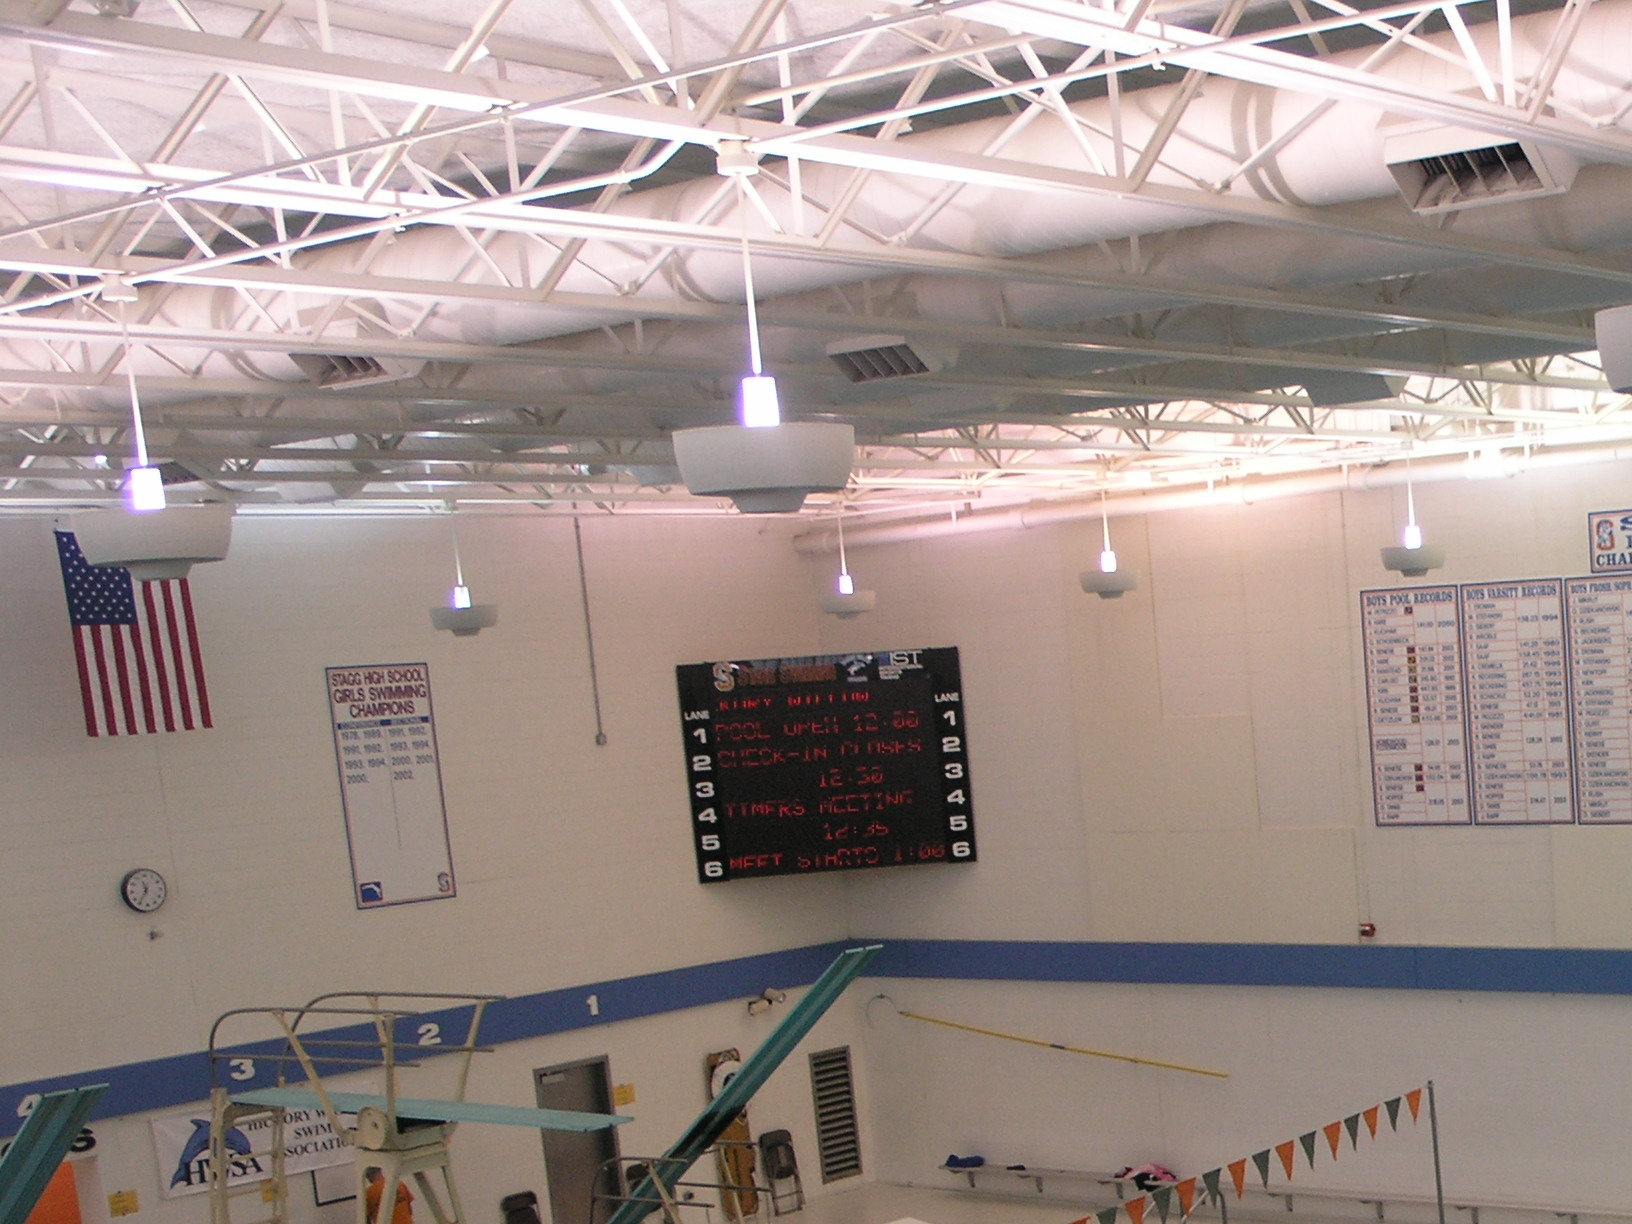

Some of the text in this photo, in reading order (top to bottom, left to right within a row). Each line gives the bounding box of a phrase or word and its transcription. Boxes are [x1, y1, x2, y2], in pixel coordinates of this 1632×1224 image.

[1366, 591, 1453, 606] BOYS POOL RECORDS
[1487, 587, 1518, 598] VARSITY
[332, 669, 424, 687] STAGG HIGH SCHOOL
[334, 684, 426, 703] GIRLS SWIMMING
[935, 692, 959, 702] LANE
[350, 700, 415, 718] CHAMPIONS
[684, 710, 710, 720] LANE
[943, 710, 956, 726] 1
[693, 728, 707, 744] 1
[942, 736, 961, 752] 2
[692, 755, 712, 772] 2
[944, 763, 963, 779] 3
[695, 782, 715, 798] 3
[947, 789, 966, 805] 4
[698, 807, 718, 823] 4
[949, 815, 968, 831] 5
[701, 835, 720, 851] 5
[952, 842, 970, 857] 6
[704, 861, 723, 877] 6
[586, 995, 598, 1015] 1
[418, 1022, 442, 1045] 2
[229, 1057, 256, 1081] 3
[294, 1123, 333, 1139] SWIM
